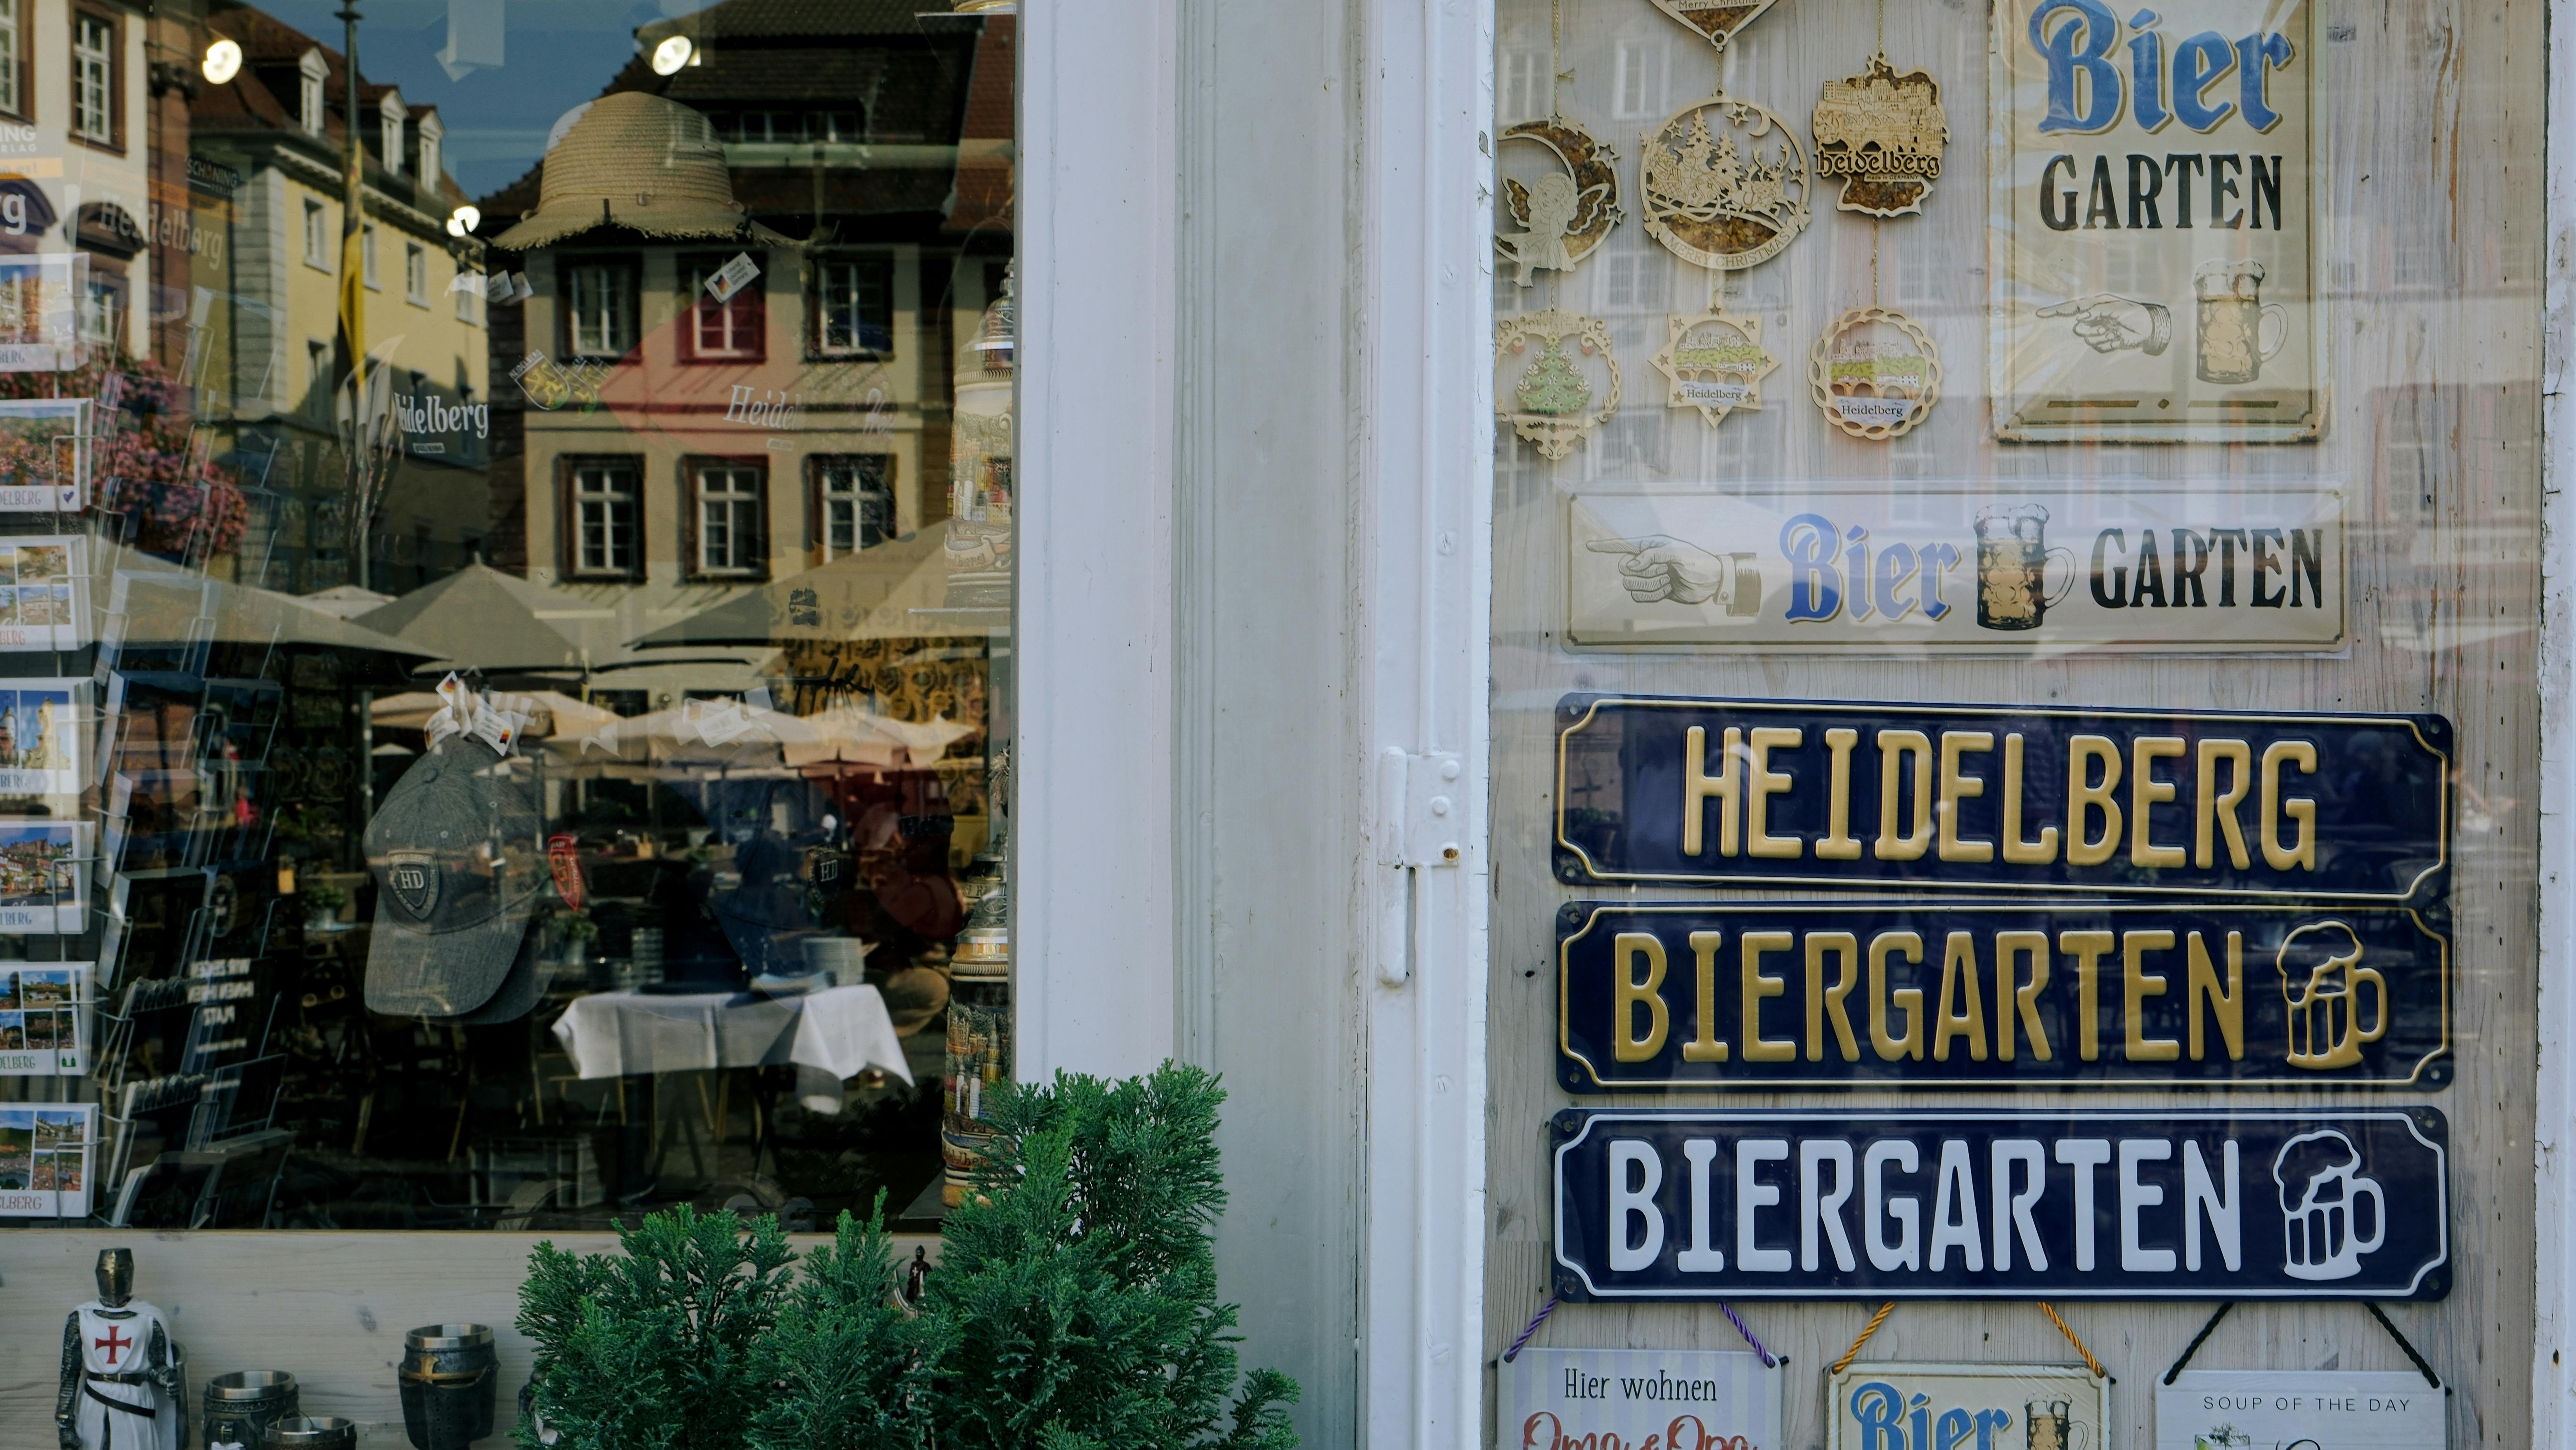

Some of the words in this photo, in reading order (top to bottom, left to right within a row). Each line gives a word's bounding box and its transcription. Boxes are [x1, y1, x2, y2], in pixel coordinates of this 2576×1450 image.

[1678, 1, 1709, 9] Merry
[2028, 0, 2296, 135] Bier
[2039, 153, 2284, 232] GARTEN
[0, 193, 26, 235] g
[98, 192, 223, 270] Heidelberg
[1666, 237, 1712, 265] MERRY
[1715, 230, 1791, 268] CHRISTMAS
[1524, 320, 1587, 332] Christmas
[1534, 310, 1571, 323] Merry
[1686, 389, 1742, 401] Heidelberg
[1842, 405, 1904, 418] Heidelberg
[394, 392, 489, 439] eidelberg
[1779, 513, 1962, 625] Bier
[2090, 526, 2323, 610] GARTEN
[1683, 724, 2318, 874] HEIDELBERG
[399, 870, 425, 889] HD
[1613, 929, 2246, 1064] BIERGARTEN
[0, 1195, 42, 1210] LBERG
[1606, 1138, 2242, 1272] BIERGARTEN
[1565, 1368, 1610, 1399] Hier
[1620, 1369, 1717, 1401] wohnen
[2203, 1396, 2263, 1410] SOUP
[2275, 1397, 2303, 1411] OF
[2315, 1398, 2356, 1412] THE
[2369, 1399, 2410, 1412] DAY
[1523, 1411, 1631, 1450] Oma
[1667, 1414, 1759, 1450] Opa
[1850, 1382, 2014, 1450] Bier
